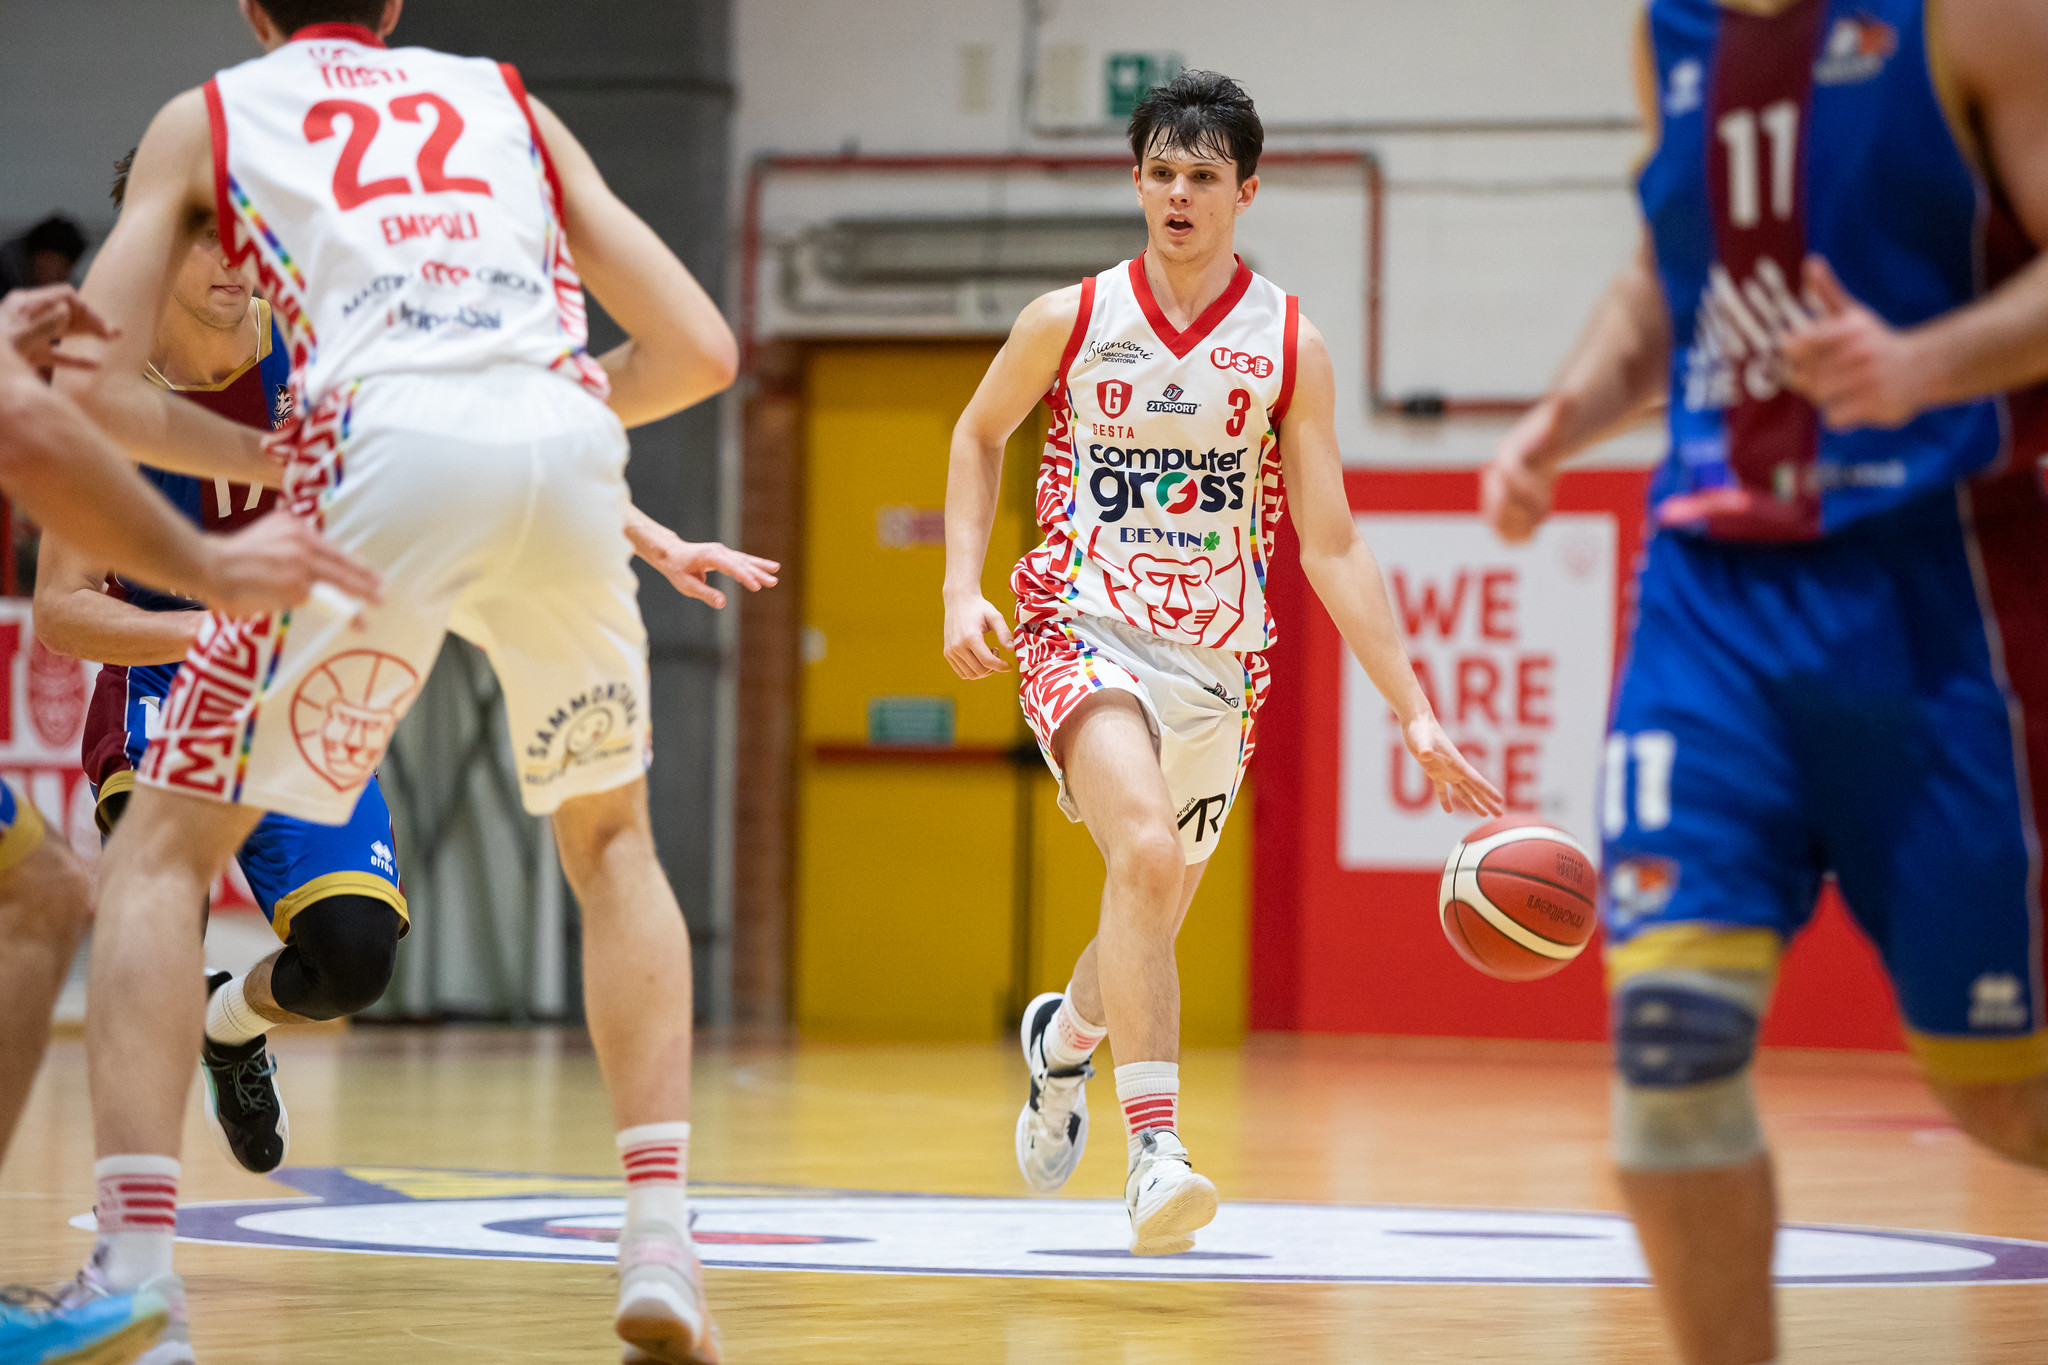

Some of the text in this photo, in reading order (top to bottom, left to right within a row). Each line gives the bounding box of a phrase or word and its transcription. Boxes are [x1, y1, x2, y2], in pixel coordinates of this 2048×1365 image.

[303, 92, 494, 211] 22
[1716, 105, 1797, 228] 11
[380, 211, 479, 246] EMPOLI
[1105, 382, 1123, 415] G
[1147, 401, 1198, 415] 2T SPORT
[1225, 388, 1251, 437] 3
[1092, 423, 1135, 439] GESTA
[1089, 444, 1248, 473] computer
[1089, 466, 1246, 523] gross
[1120, 527, 1202, 547] BEYFIN
[1392, 567, 1517, 640] WE
[1603, 730, 1676, 838] 11
[1527, 893, 1586, 929] molten
